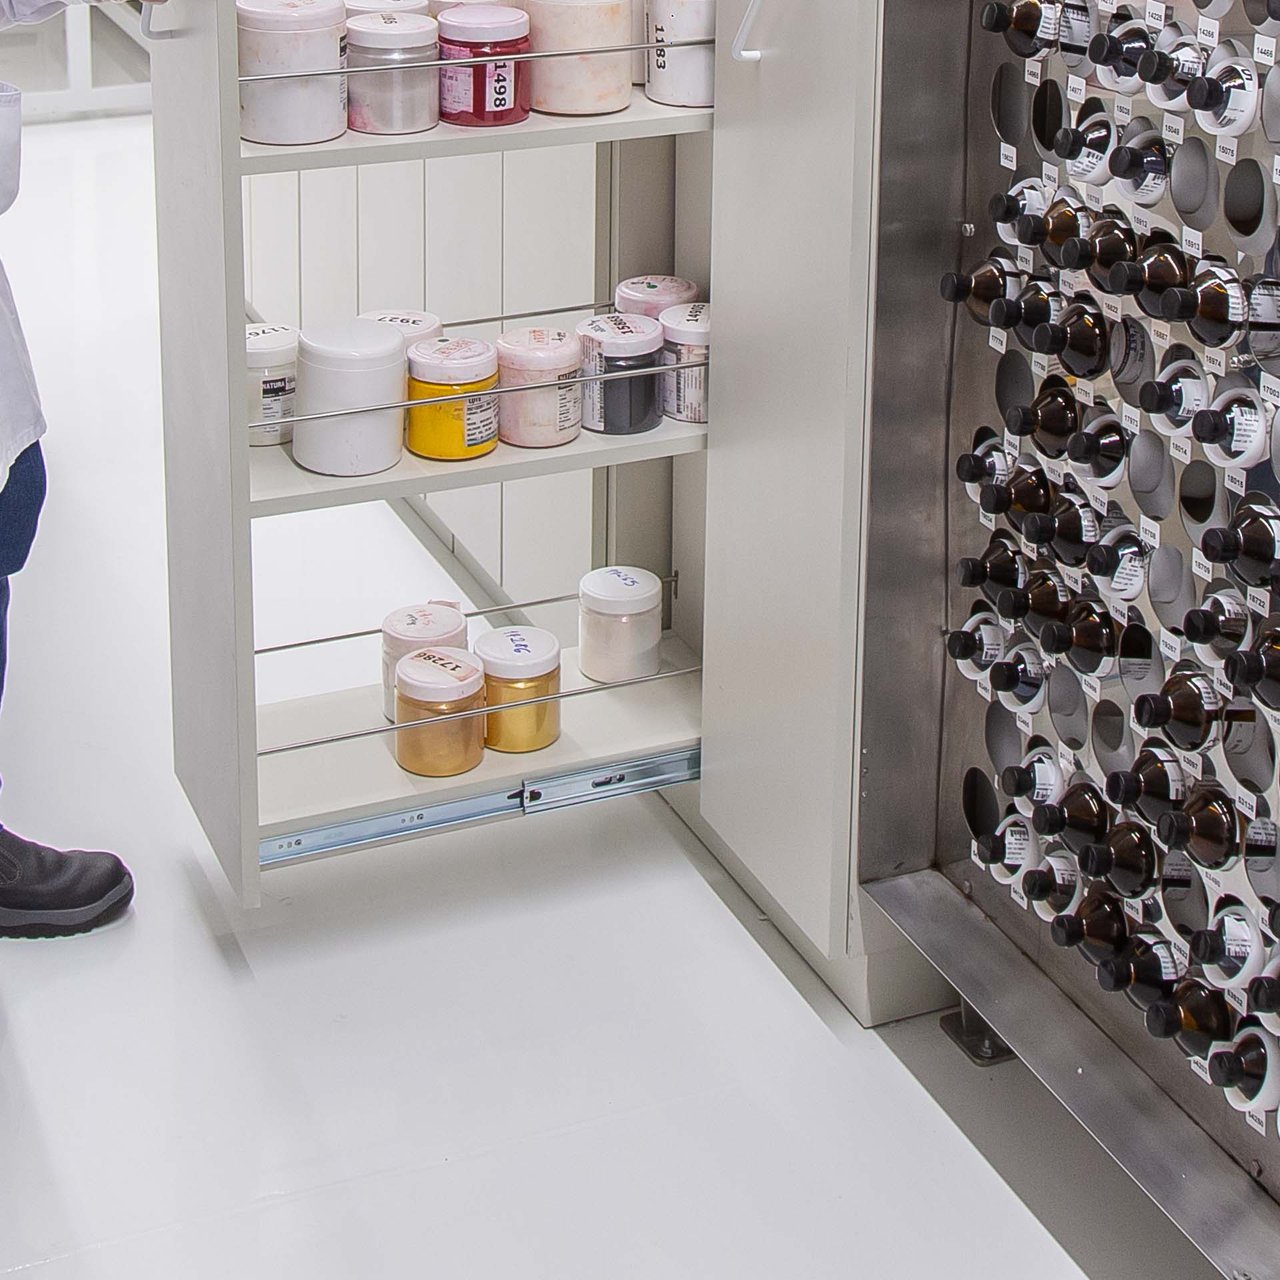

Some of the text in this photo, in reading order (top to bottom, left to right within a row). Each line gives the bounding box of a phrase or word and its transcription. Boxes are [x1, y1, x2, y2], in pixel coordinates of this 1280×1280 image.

[655, 24, 667, 70] 1183
[493, 62, 507, 108] 1498
[246, 326, 290, 340] 1176
